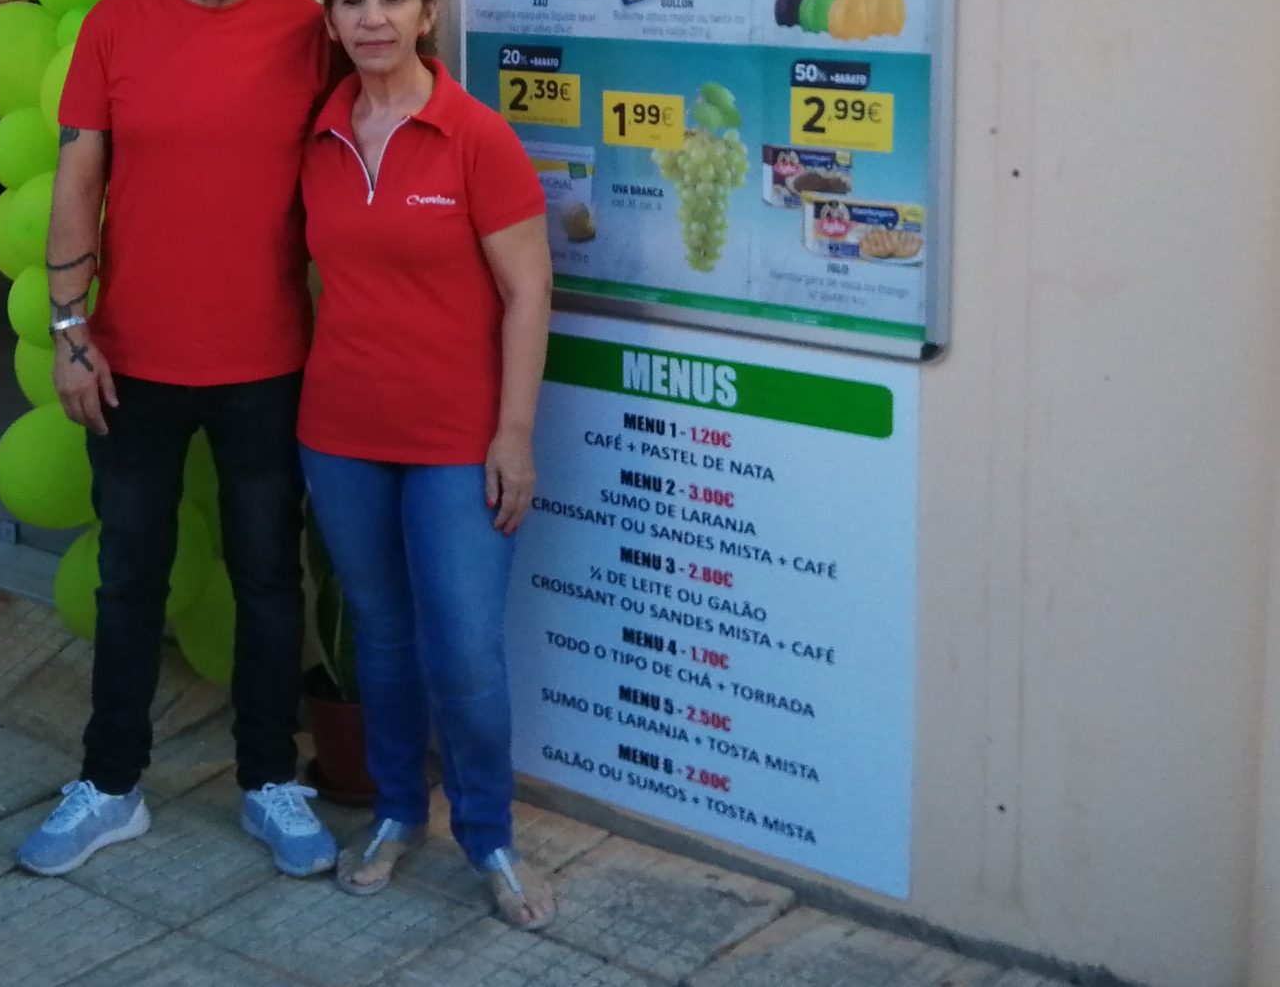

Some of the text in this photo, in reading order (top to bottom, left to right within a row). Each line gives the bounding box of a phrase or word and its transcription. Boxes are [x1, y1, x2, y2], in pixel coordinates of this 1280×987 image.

[612, 183, 665, 198] UVA BRANCA
[622, 350, 738, 408] MENUS
[623, 412, 665, 436] MENU
[670, 422, 677, 438] 1
[584, 430, 623, 452] CAFÉ
[641, 441, 698, 468] PASTEL
[703, 455, 724, 472] DE
[729, 460, 775, 482] NATA
[620, 468, 662, 493] MENU
[665, 479, 676, 496] 2
[600, 489, 756, 536] SUMO DE LARANJA
[531, 497, 616, 528] CROISSANT
[621, 517, 646, 535] OU
[650, 523, 714, 551] SANDES
[720, 539, 773, 564] MISTA
[793, 556, 838, 580] CAFÉ
[620, 546, 662, 571] MENU
[665, 557, 676, 574] 3
[531, 574, 616, 607] CROISSANT
[620, 597, 645, 614] OU
[649, 604, 714, 633] SANDES
[719, 622, 772, 648] MISTA
[791, 641, 835, 665] CAFÉ
[606, 569, 627, 588] DE
[632, 577, 672, 599] LEITE
[676, 588, 703, 606] OU
[707, 595, 767, 622] GALÃO
[622, 626, 664, 652] MENU
[667, 639, 677, 656] 4
[545, 630, 590, 655] TODO
[594, 644, 607, 659] O
[611, 648, 648, 671] TIPO
[652, 660, 673, 678] DE
[677, 668, 712, 690] CHÁ
[731, 683, 816, 718] TORRADA
[618, 684, 660, 711] MENU
[663, 697, 674, 715] 5
[541, 686, 589, 713] SUMO
[592, 702, 613, 721] DE
[617, 711, 689, 743] LARANJA
[708, 735, 760, 764] TOSTA
[764, 753, 820, 782] MISTA
[618, 743, 659, 770] MENU
[541, 744, 595, 773] GALÃO
[598, 763, 622, 782] OU
[627, 772, 687, 802] SUMOS
[705, 795, 758, 826] TOSTA
[762, 815, 817, 845] MISTA
